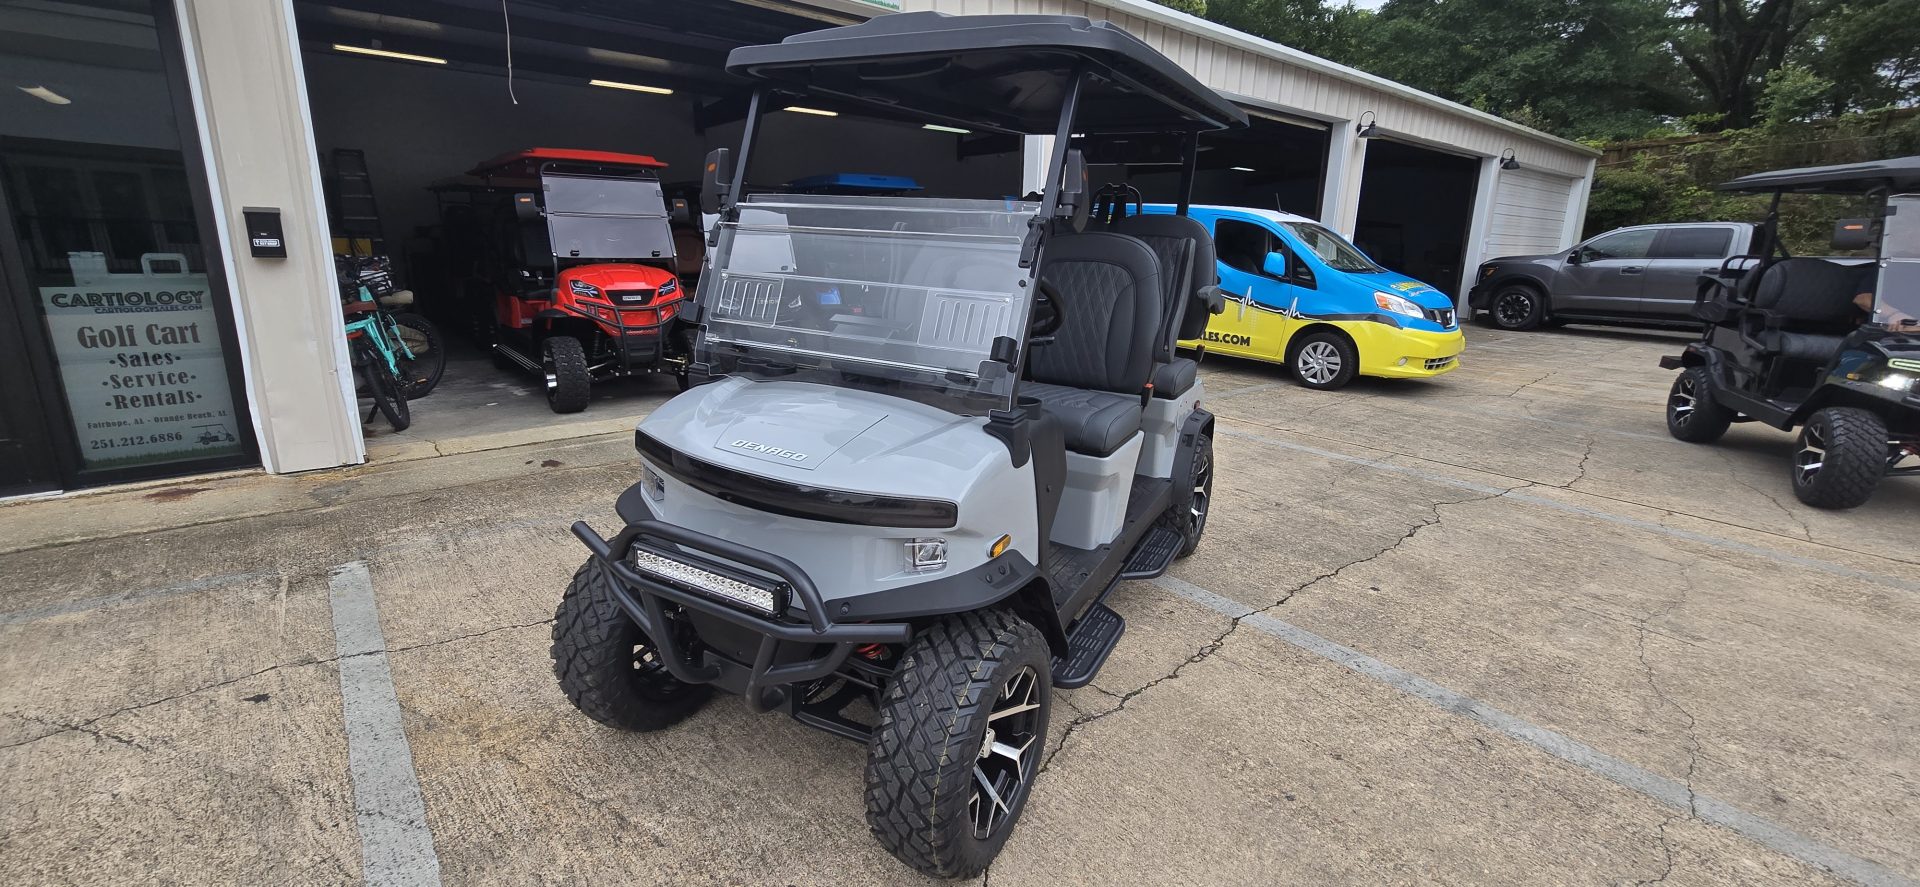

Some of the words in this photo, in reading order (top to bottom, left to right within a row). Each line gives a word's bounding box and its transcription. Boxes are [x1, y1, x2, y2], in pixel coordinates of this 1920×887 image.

[51, 290, 204, 308] CARTIOLOGY
[95, 304, 203, 314] CARTIOLOGYSALES.COM
[77, 324, 138, 349] Golf
[145, 322, 201, 345] Cart
[1201, 331, 1251, 347] LES.COM
[87, 420, 131, 430] Fairhope,
[154, 414, 185, 423] Orange
[187, 411, 216, 420] Beach,
[90, 431, 183, 450] 251.212.6886
[731, 439, 808, 462] DENAGO
